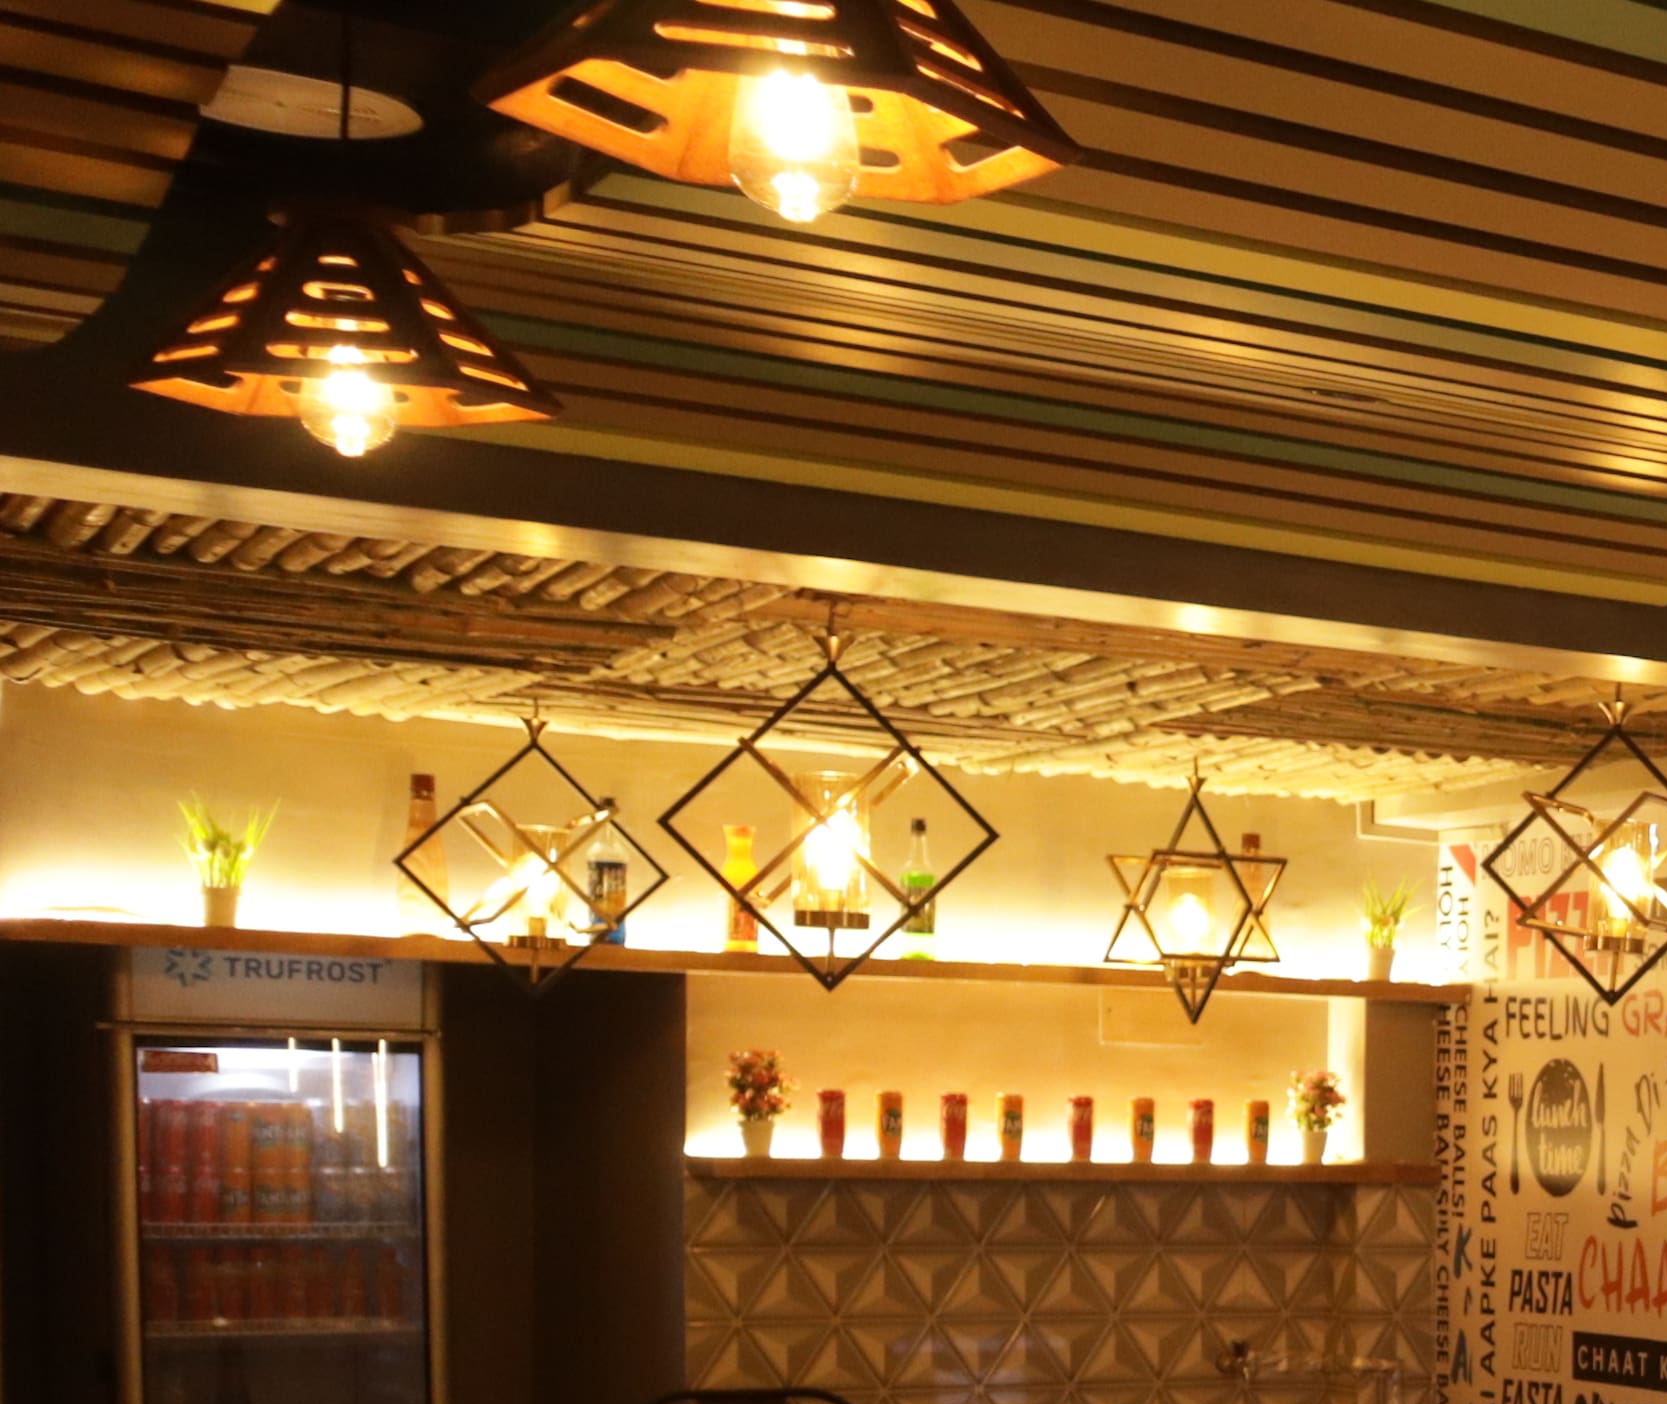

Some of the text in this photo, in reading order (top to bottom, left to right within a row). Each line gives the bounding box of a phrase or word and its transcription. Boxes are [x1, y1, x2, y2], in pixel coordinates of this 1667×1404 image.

[224, 954, 385, 984] TRUFROST
[1507, 890, 1626, 981] PIZZ
[1437, 1003, 1452, 1101] HEESE
[1453, 1003, 1469, 1113] CHEESE
[1482, 1019, 1499, 1099] KYA
[1504, 995, 1610, 1041] FEELING
[1451, 1124, 1467, 1218] BALLS!
[1481, 1114, 1498, 1225] PAAS
[1524, 1211, 1570, 1261] EAT
[1436, 1264, 1450, 1363] CHEESE
[1480, 1237, 1497, 1377] AAPKE
[1508, 1268, 1574, 1317] PASTA
[1512, 1321, 1564, 1374] RUN
[1576, 1345, 1649, 1378] CHAAT
